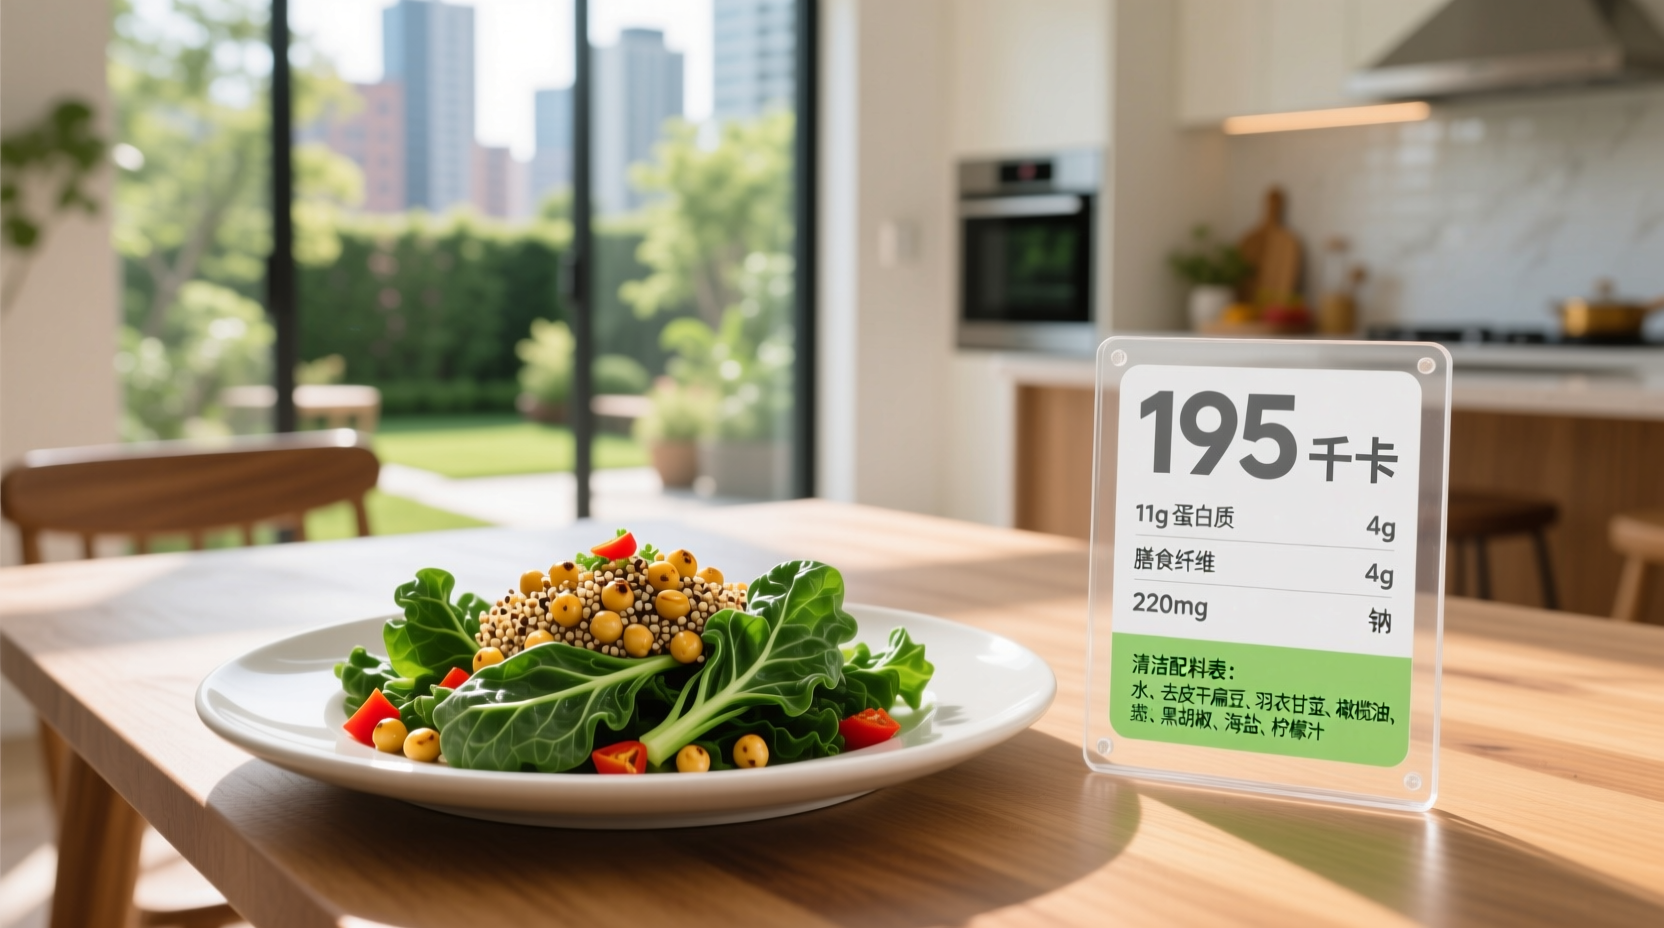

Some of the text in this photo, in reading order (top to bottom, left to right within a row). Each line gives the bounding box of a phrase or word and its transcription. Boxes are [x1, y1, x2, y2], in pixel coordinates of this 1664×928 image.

[1140, 390, 1399, 484] 195 千卡
[1136, 503, 1235, 529] 11g 蛋白质
[1366, 515, 1396, 543] 4g
[1133, 546, 1216, 573] 膳食纤维
[1364, 563, 1394, 590] 4g
[1132, 592, 1208, 621] 220mg
[1368, 606, 1393, 634] 钠
